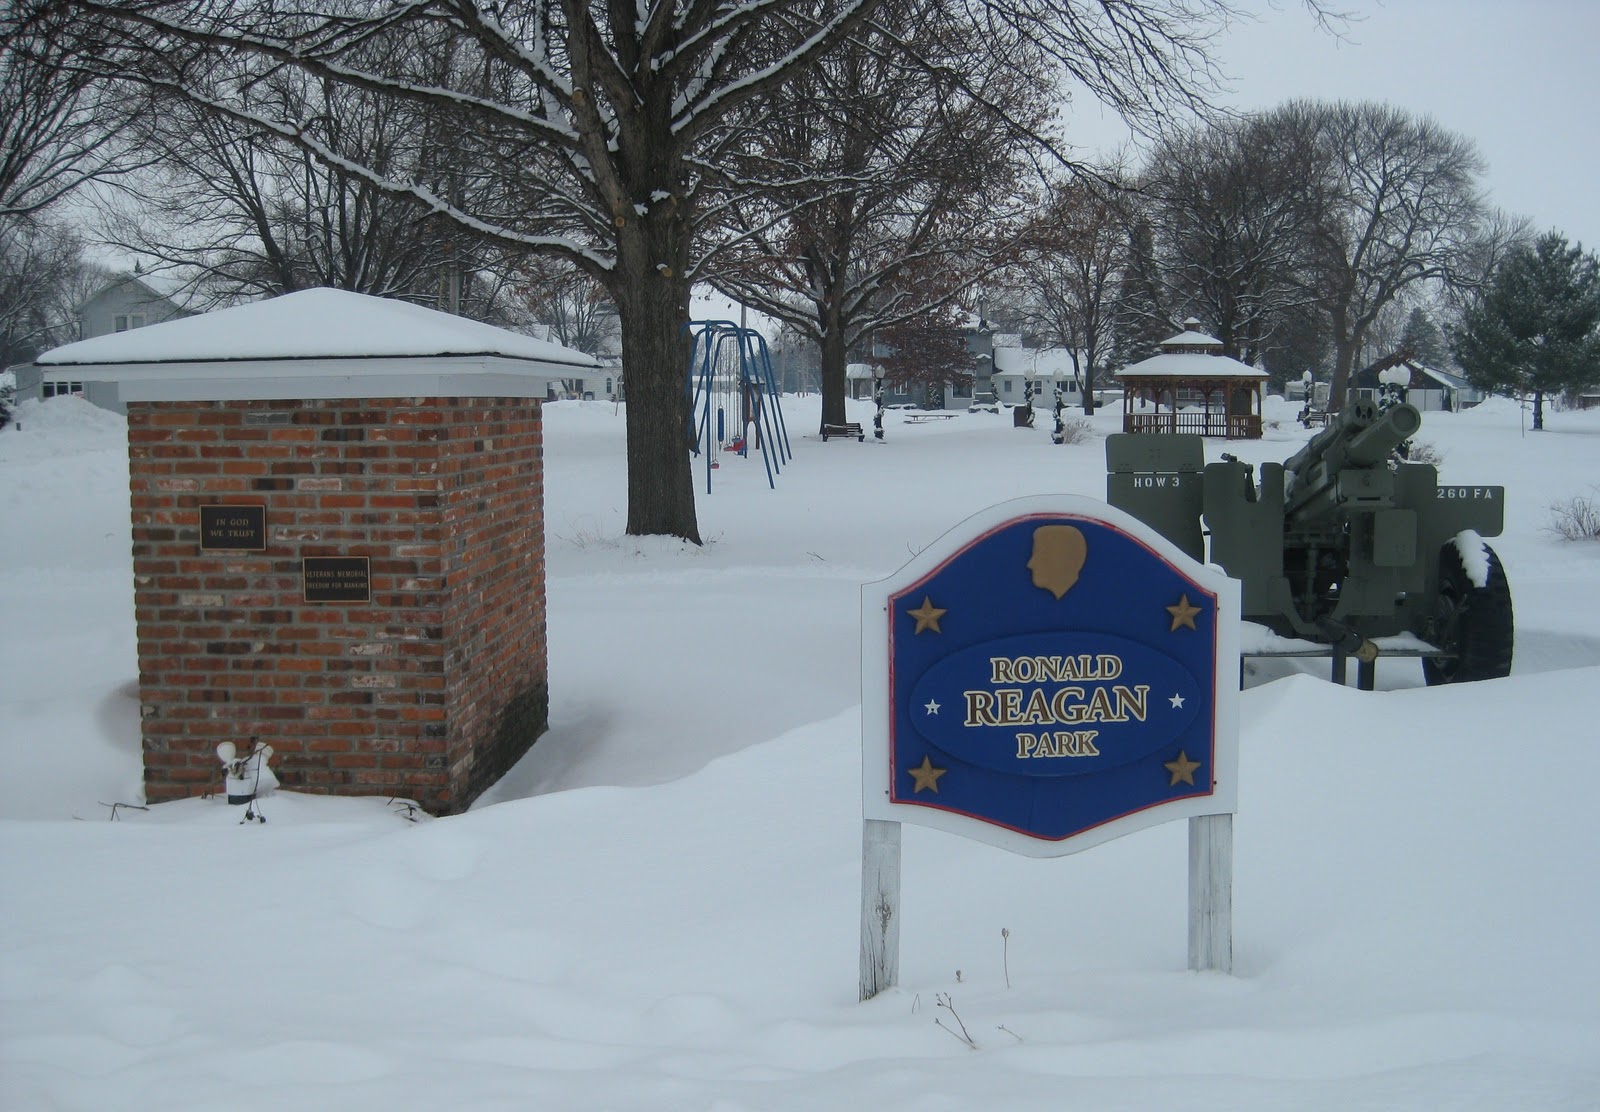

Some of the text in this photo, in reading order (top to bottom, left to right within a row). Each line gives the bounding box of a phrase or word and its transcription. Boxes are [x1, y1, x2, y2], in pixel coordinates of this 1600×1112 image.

[1134, 477, 1180, 488] HOW 3
[1437, 488, 1492, 499] 260 FA
[216, 518, 249, 526] IN GOD
[337, 570, 367, 578] MEMORIAL
[990, 654, 1122, 683] RONALD
[963, 685, 1150, 727] REAGAN
[1016, 730, 1100, 758] PARK
